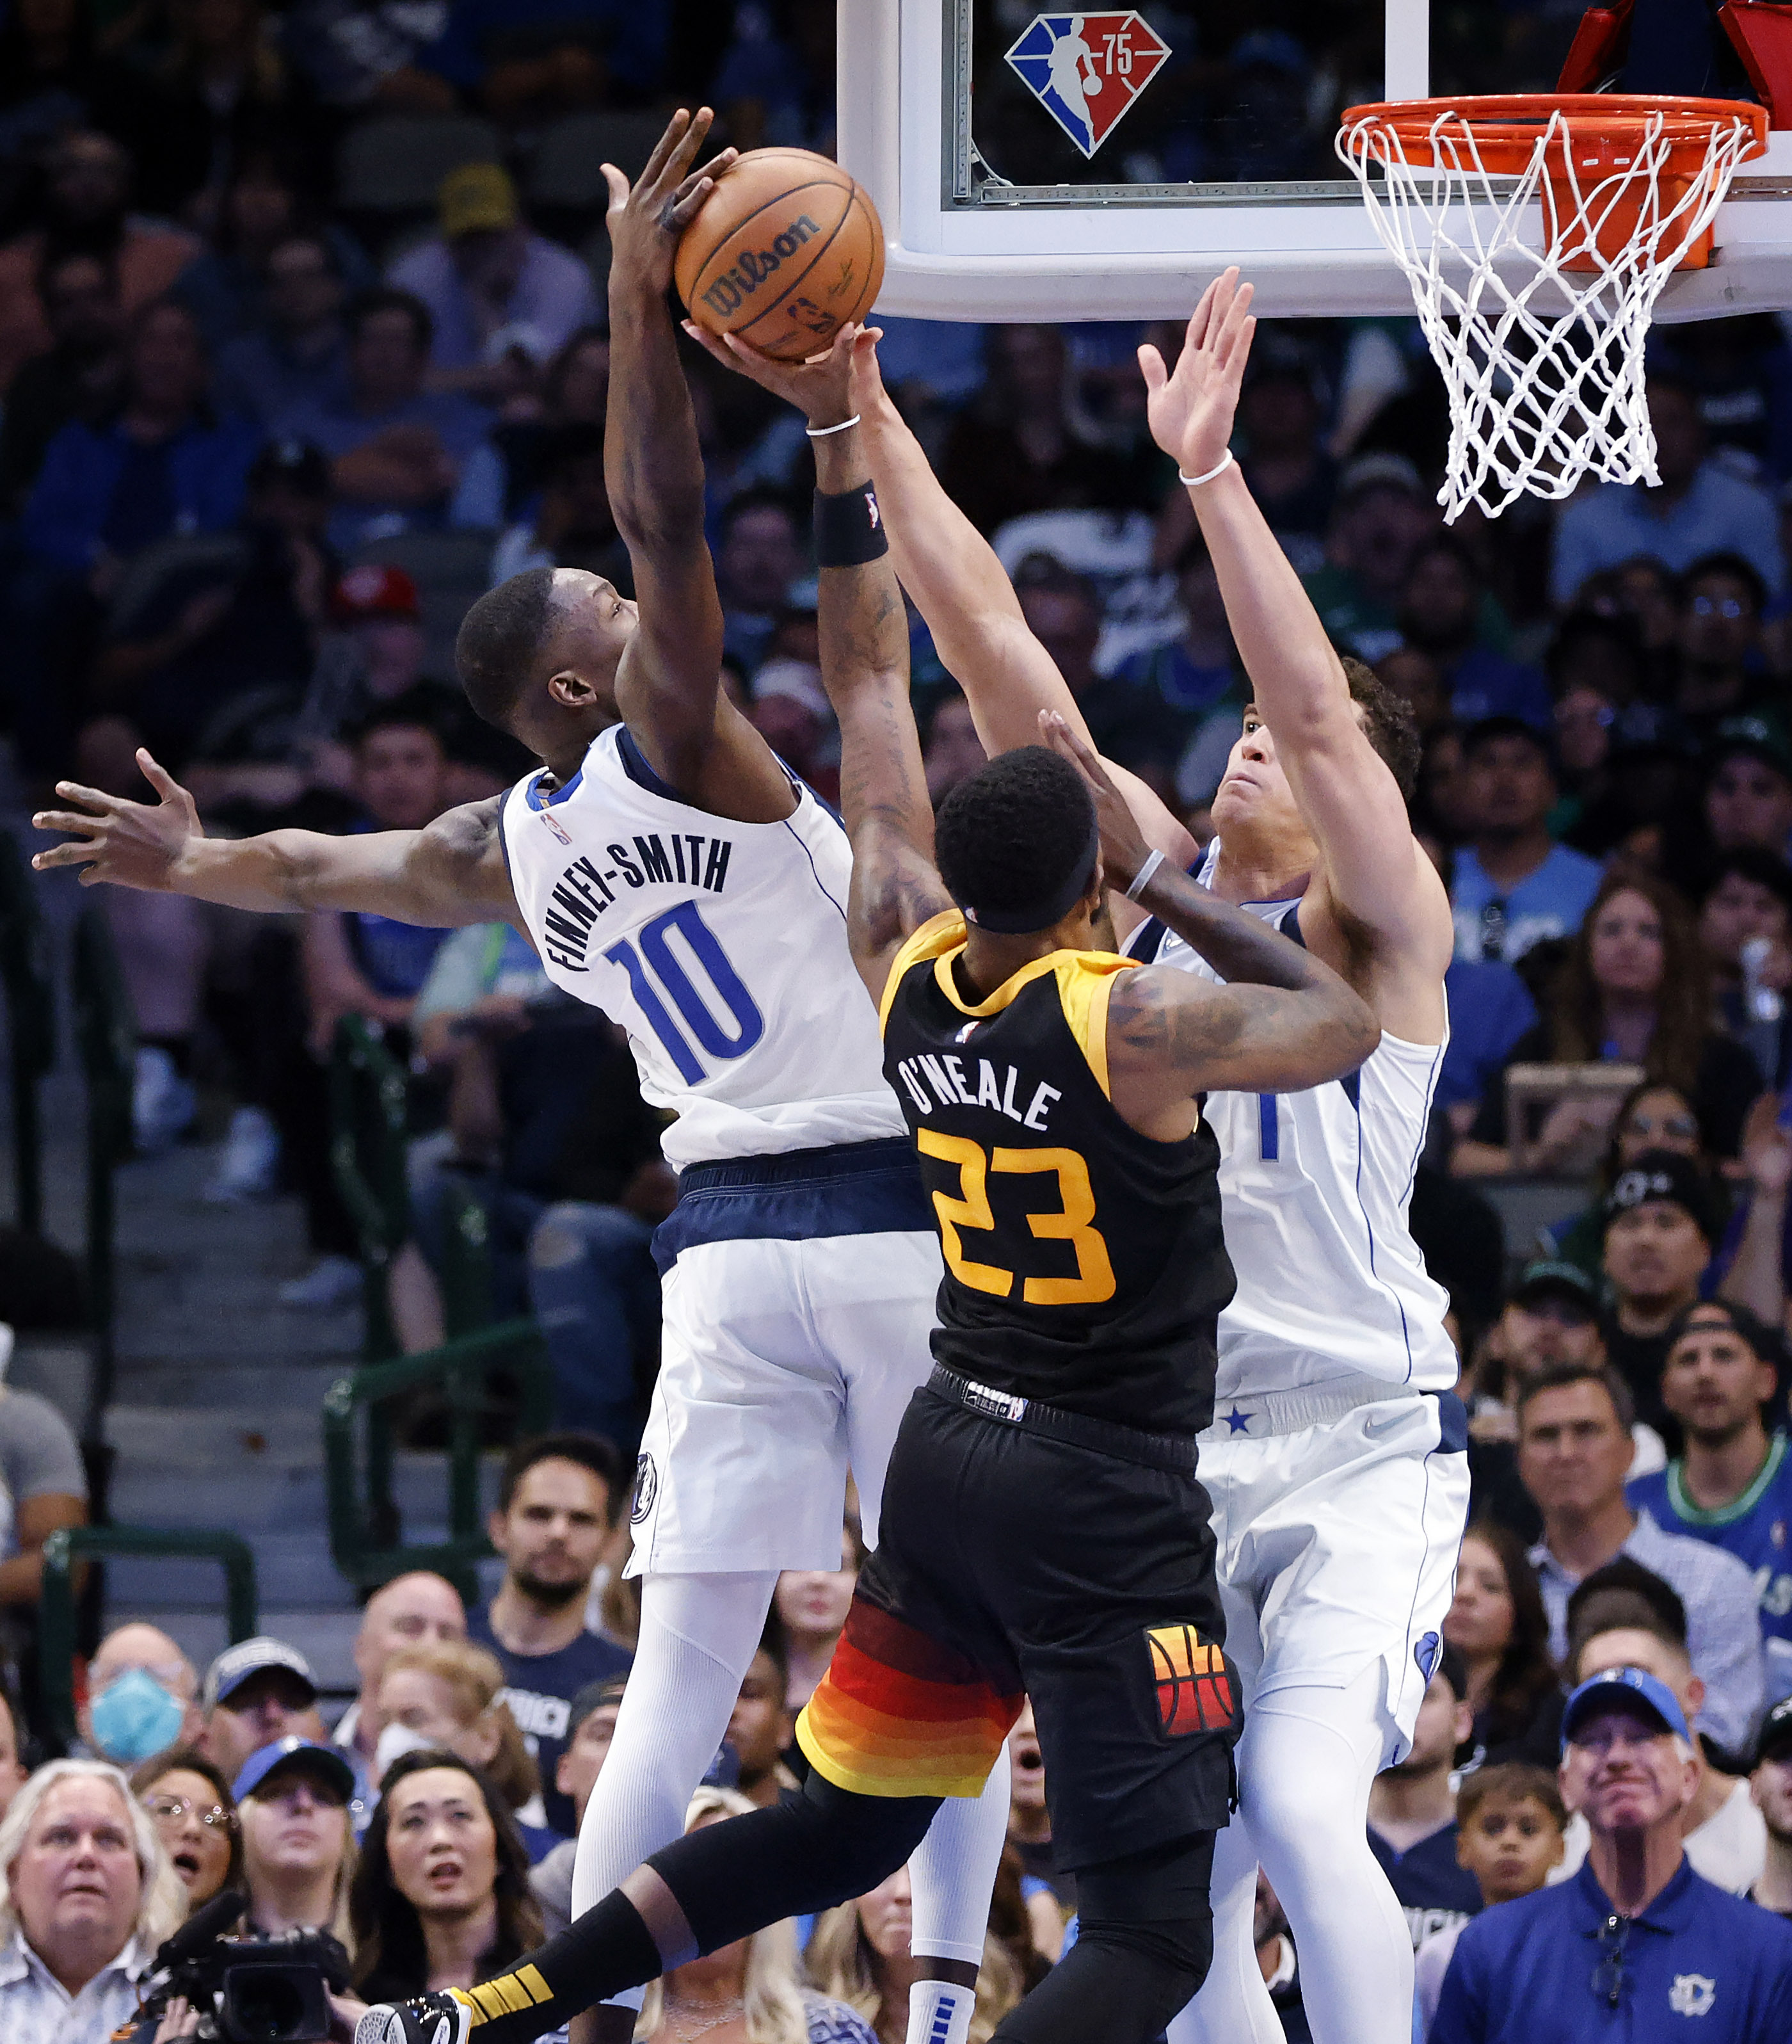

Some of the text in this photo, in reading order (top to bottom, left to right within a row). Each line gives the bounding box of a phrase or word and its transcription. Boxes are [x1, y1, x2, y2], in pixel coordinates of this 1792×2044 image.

[1102, 33, 1132, 75] 75
[701, 214, 821, 318] Wilson
[545, 833, 732, 972] FINNEY-SMITH
[602, 899, 765, 1087] 10
[898, 1054, 1062, 1132] O'NEALE
[917, 1127, 1117, 1306] 23
